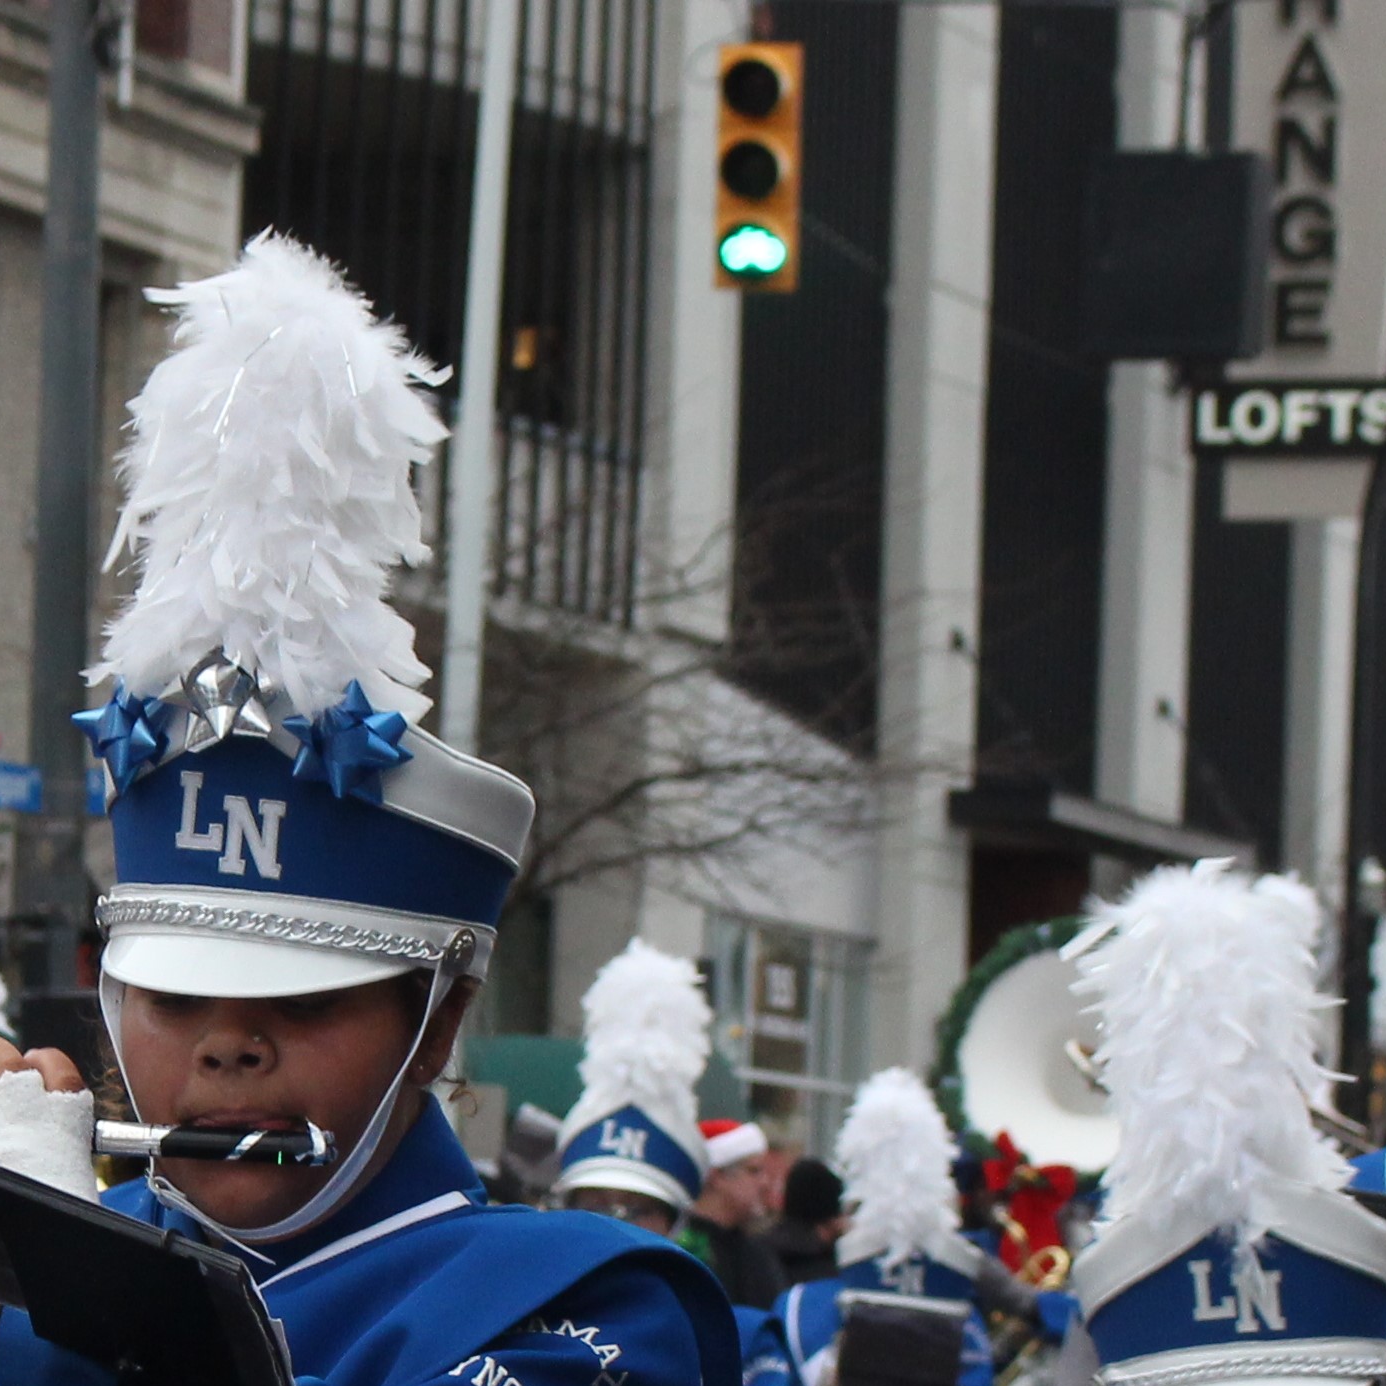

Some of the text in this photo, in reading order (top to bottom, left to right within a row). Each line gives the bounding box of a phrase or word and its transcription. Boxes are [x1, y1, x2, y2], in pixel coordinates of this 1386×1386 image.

[175, 770, 287, 880] LN
[598, 1118, 648, 1160] LN
[1187, 1259, 1288, 1334] LN
